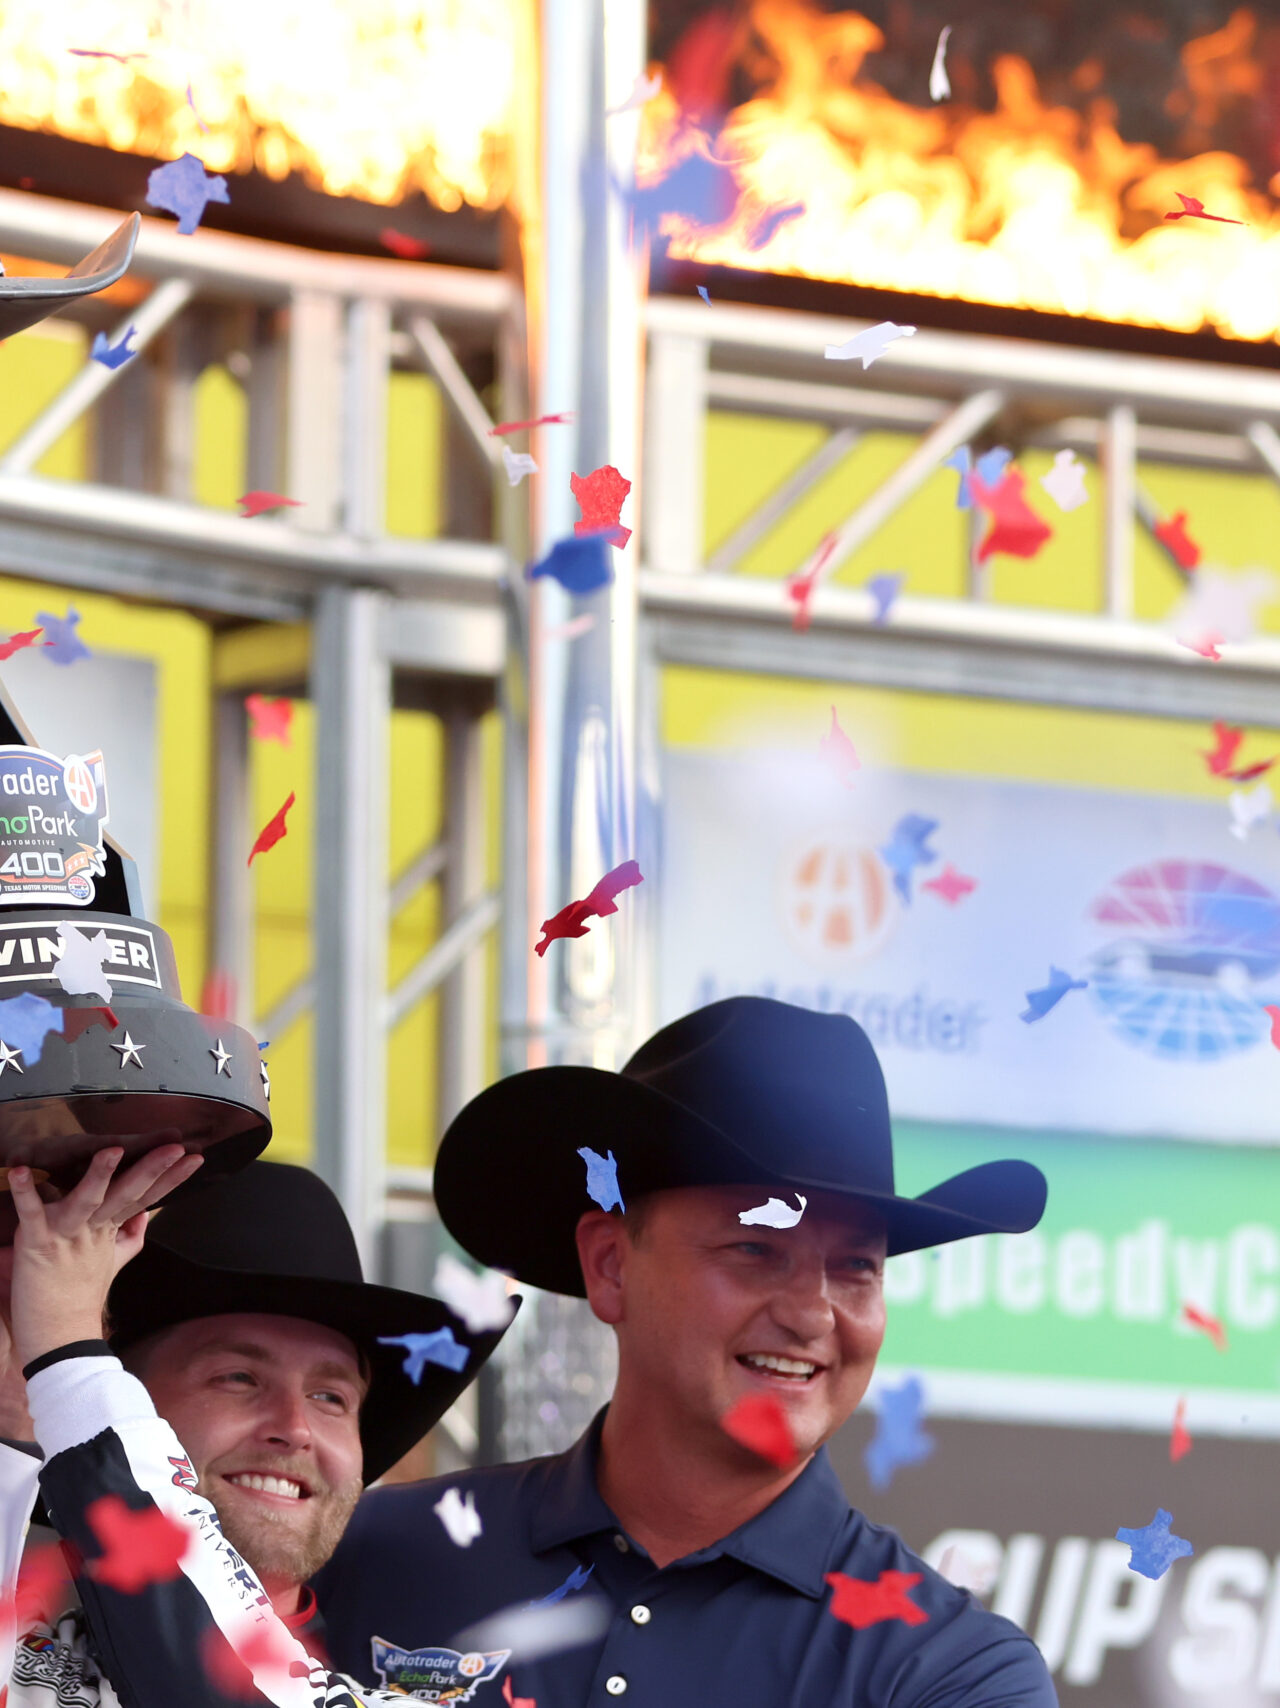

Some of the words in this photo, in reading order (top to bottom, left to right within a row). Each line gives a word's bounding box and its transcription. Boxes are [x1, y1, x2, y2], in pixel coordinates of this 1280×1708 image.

[1, 839, 56, 847] AUTOMOTIVE
[0, 852, 66, 877] 400
[4, 884, 22, 892] TEXAS
[42, 884, 67, 892] SPEEDWAY
[696, 971, 986, 1054] trader
[194, 1512, 269, 1624] NIVERSIT
[384, 1655, 456, 1669] Autotrader
[399, 1670, 457, 1685] EchoPark
